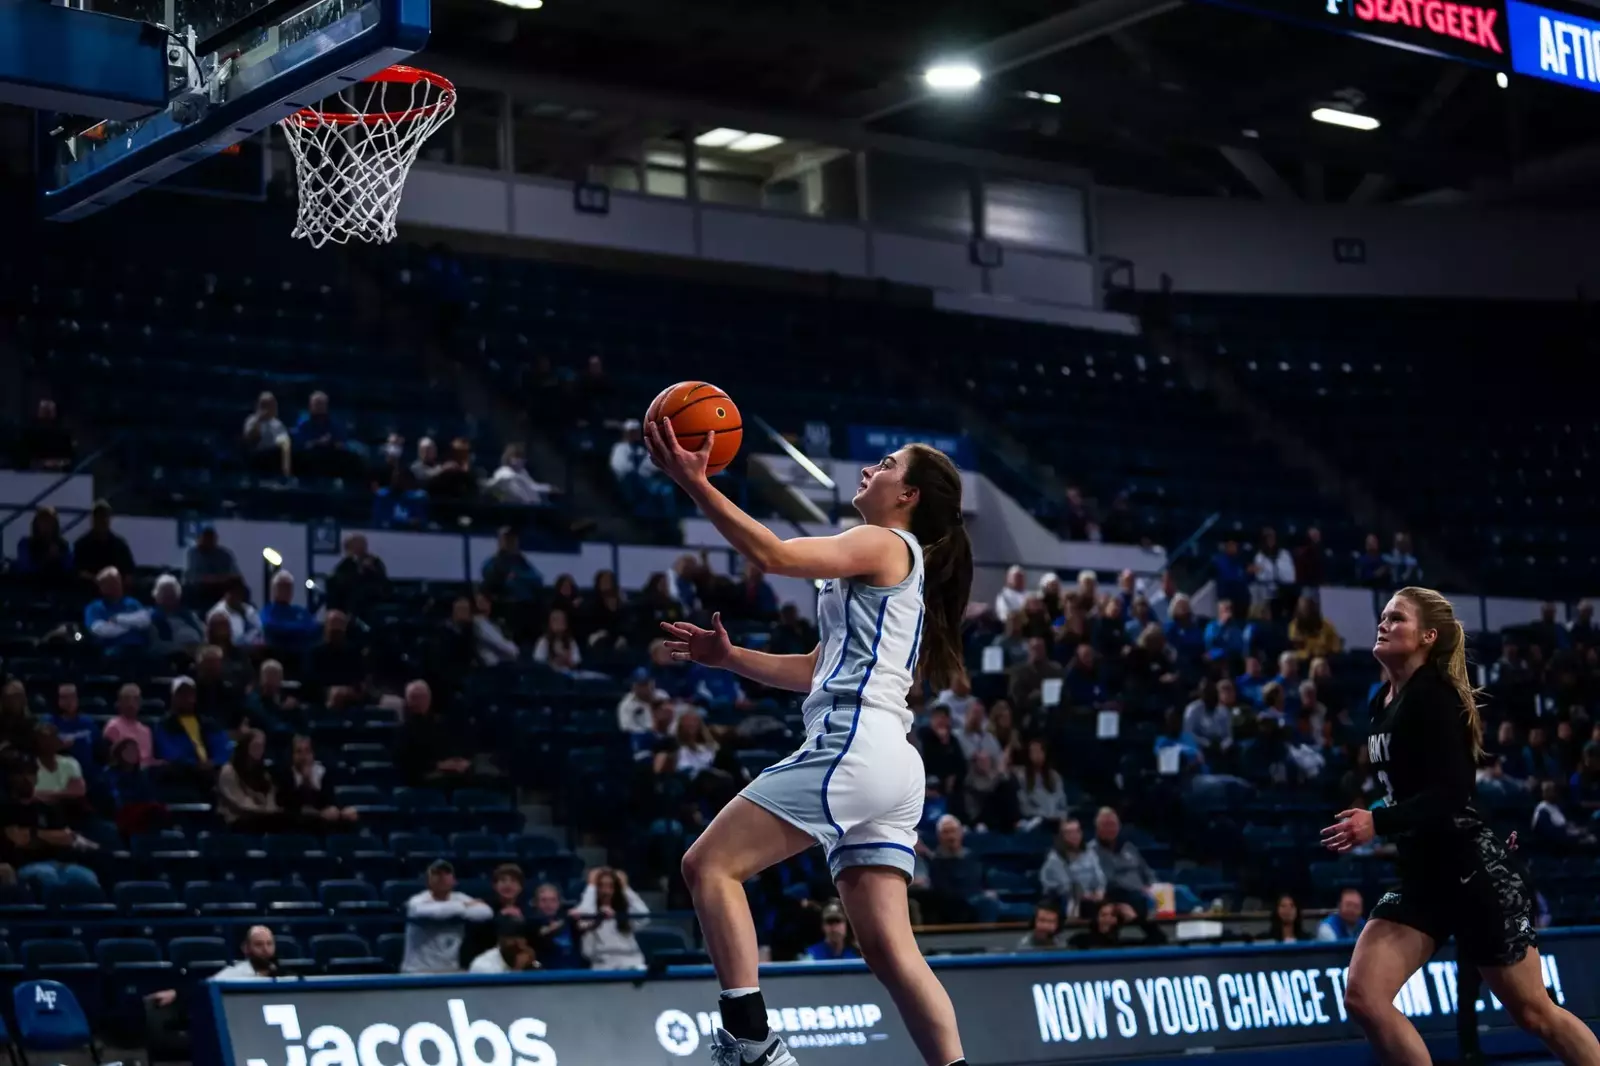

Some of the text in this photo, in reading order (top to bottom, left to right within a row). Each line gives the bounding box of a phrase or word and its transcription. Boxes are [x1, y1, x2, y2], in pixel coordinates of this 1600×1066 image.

[1354, 0, 1504, 54] SEATGEEK
[247, 998, 557, 1066] Jacobs
[695, 1003, 882, 1036] MBERSHIP
[1032, 979, 1138, 1043] NOW'S
[1134, 975, 1219, 1036] YOUR
[1217, 968, 1331, 1032] CHANCE
[1325, 966, 1350, 1023] T
